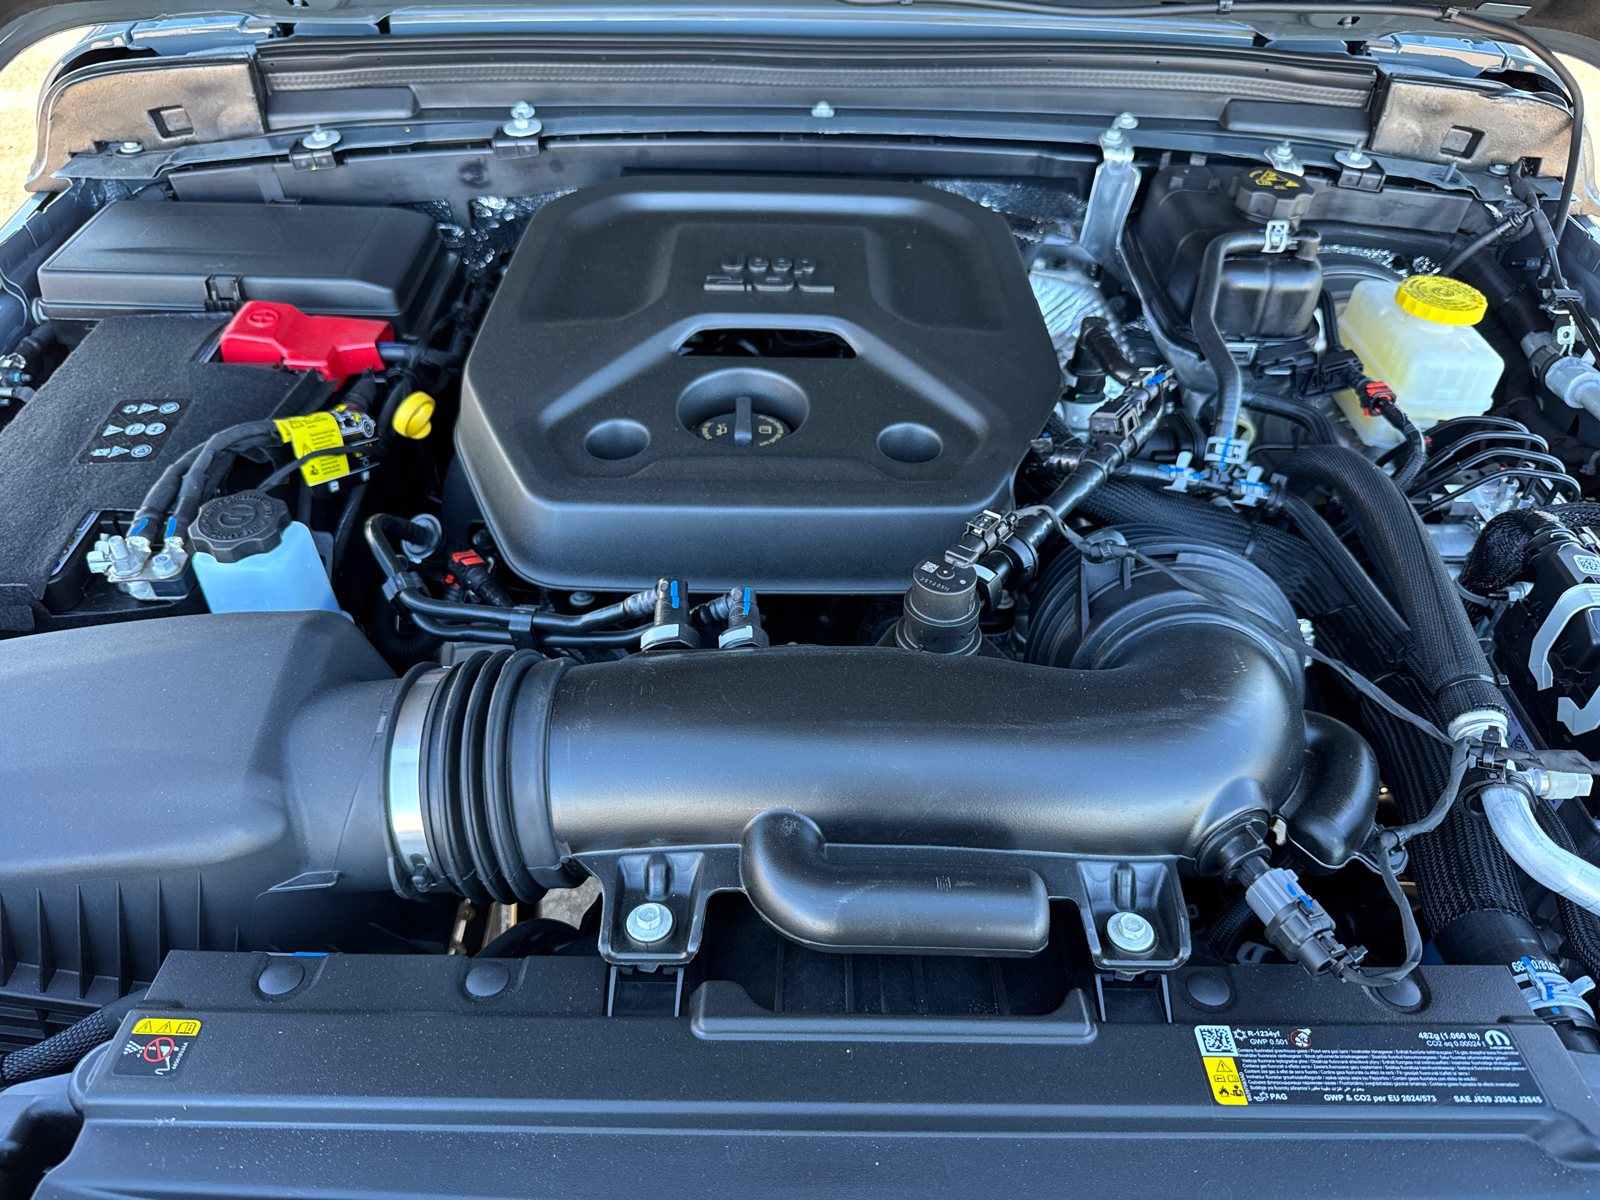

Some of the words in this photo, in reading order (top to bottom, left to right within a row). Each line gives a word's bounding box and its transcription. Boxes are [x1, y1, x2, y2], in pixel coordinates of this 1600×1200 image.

[720, 252, 816, 277] Jeep
[703, 274, 836, 293] 2.0L
[1418, 1032, 1440, 1041] 482g
[1440, 1032, 1466, 1041] (1.060
[1468, 1032, 1481, 1041] lb)
[1249, 1038, 1268, 1046] GWP
[1269, 1038, 1289, 1046] 0.501
[1269, 1093, 1288, 1101] PAG
[1353, 1094, 1372, 1102] CO2
[1372, 1095, 1386, 1103] per
[1453, 1095, 1472, 1103] SAE
